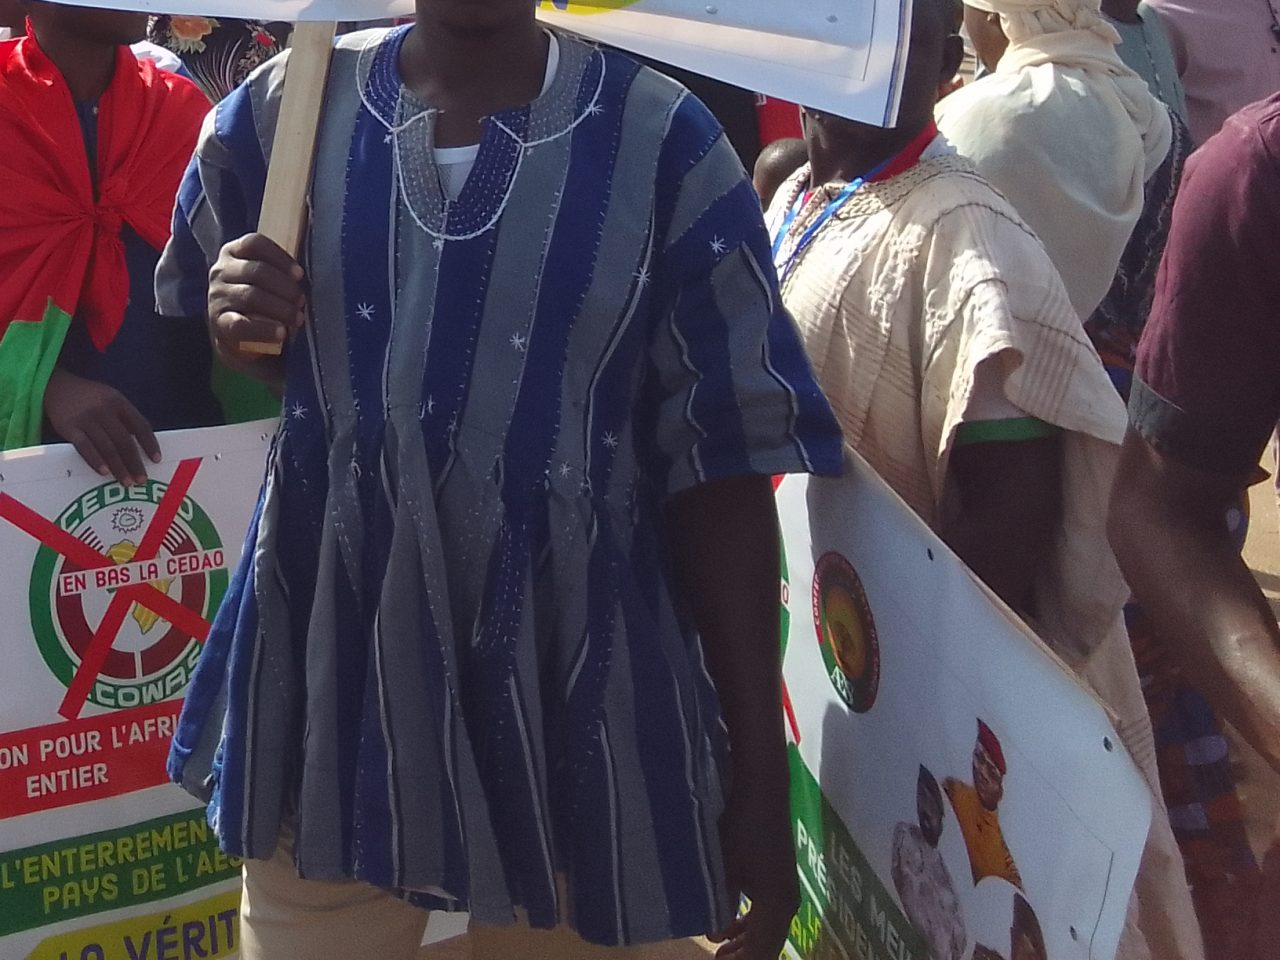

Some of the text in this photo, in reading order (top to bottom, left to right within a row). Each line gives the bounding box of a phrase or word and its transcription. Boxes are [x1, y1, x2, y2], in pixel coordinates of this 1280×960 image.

[63, 550, 225, 594] EN BAS LA CEDAO
[81, 646, 201, 707] COWAS
[39, 731, 102, 762] POUR
[111, 714, 177, 749] L'AFRI
[26, 763, 110, 799] ENTIER
[1, 817, 208, 889] L'ENTERREMEN
[42, 873, 119, 915] PAYS
[132, 863, 167, 896] DE
[123, 908, 238, 960] VÉRIT
